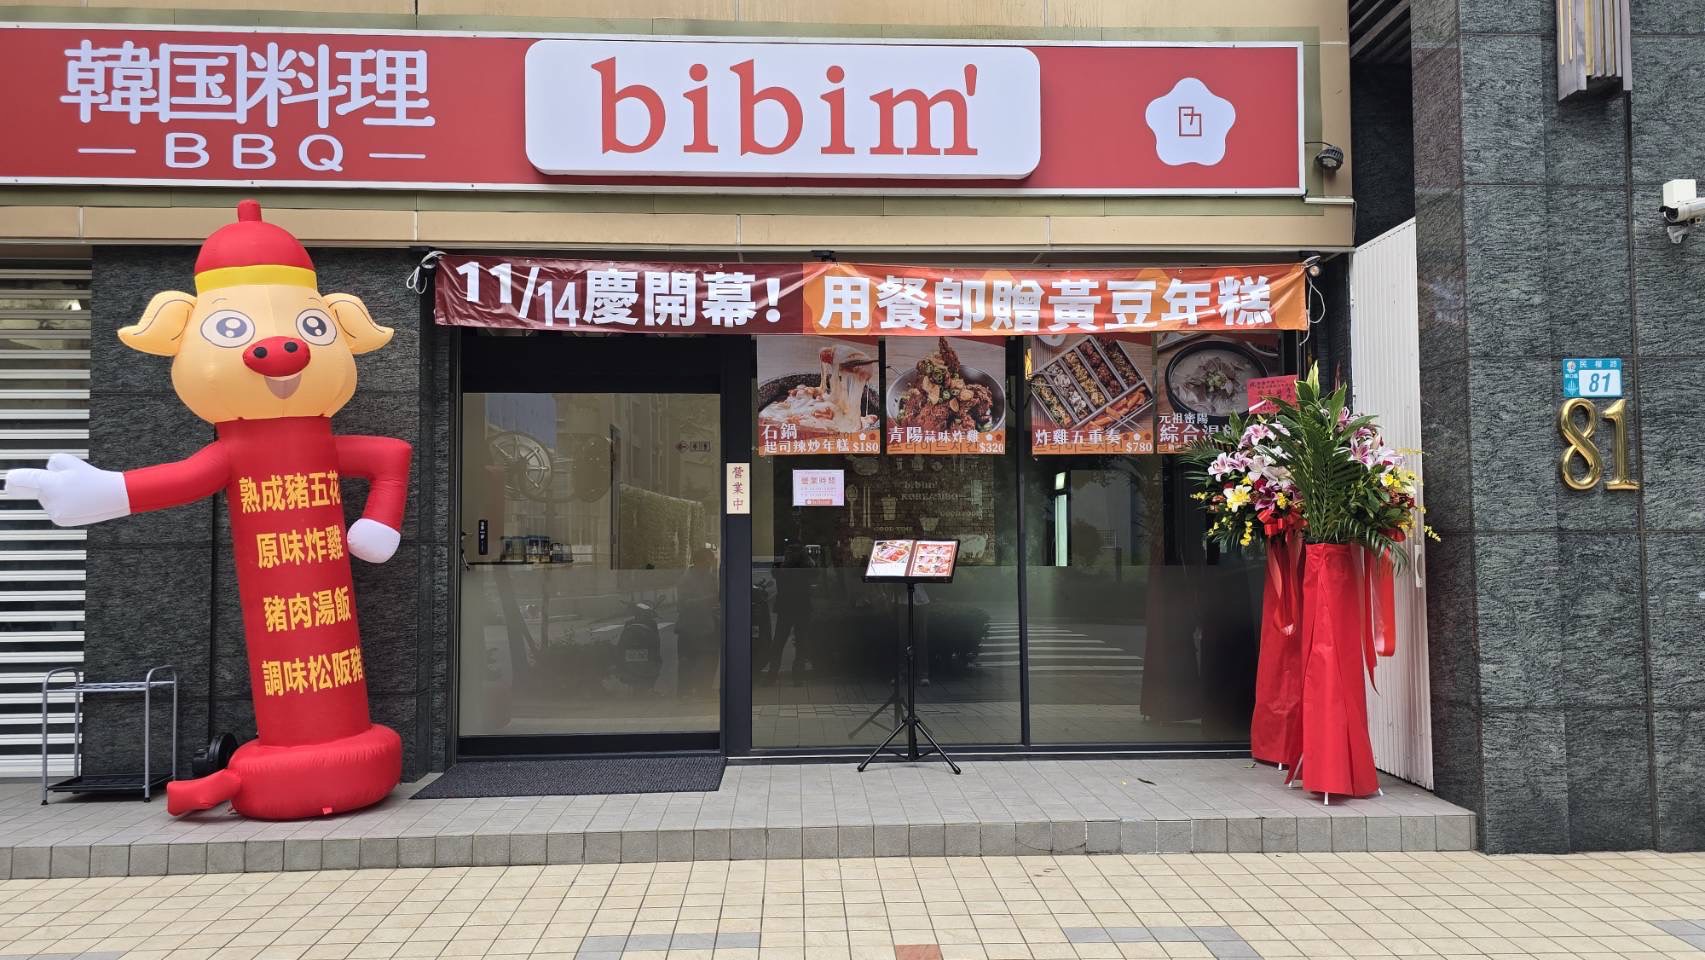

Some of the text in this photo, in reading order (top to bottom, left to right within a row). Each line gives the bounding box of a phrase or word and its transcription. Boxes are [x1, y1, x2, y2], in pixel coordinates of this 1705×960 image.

[60, 39, 435, 129] 韓国料理
[165, 132, 345, 173] BBQ
[1588, 372, 1612, 393] 81
[761, 422, 798, 440] 石鍋
[853, 441, 879, 453] $180
[979, 442, 1005, 454] $320
[1126, 441, 1152, 453] $780
[1560, 397, 1641, 491] 81
[731, 465, 745, 511] 營業中
[256, 524, 344, 569] 原味炸雞
[263, 585, 352, 633] 豬肉湯飯
